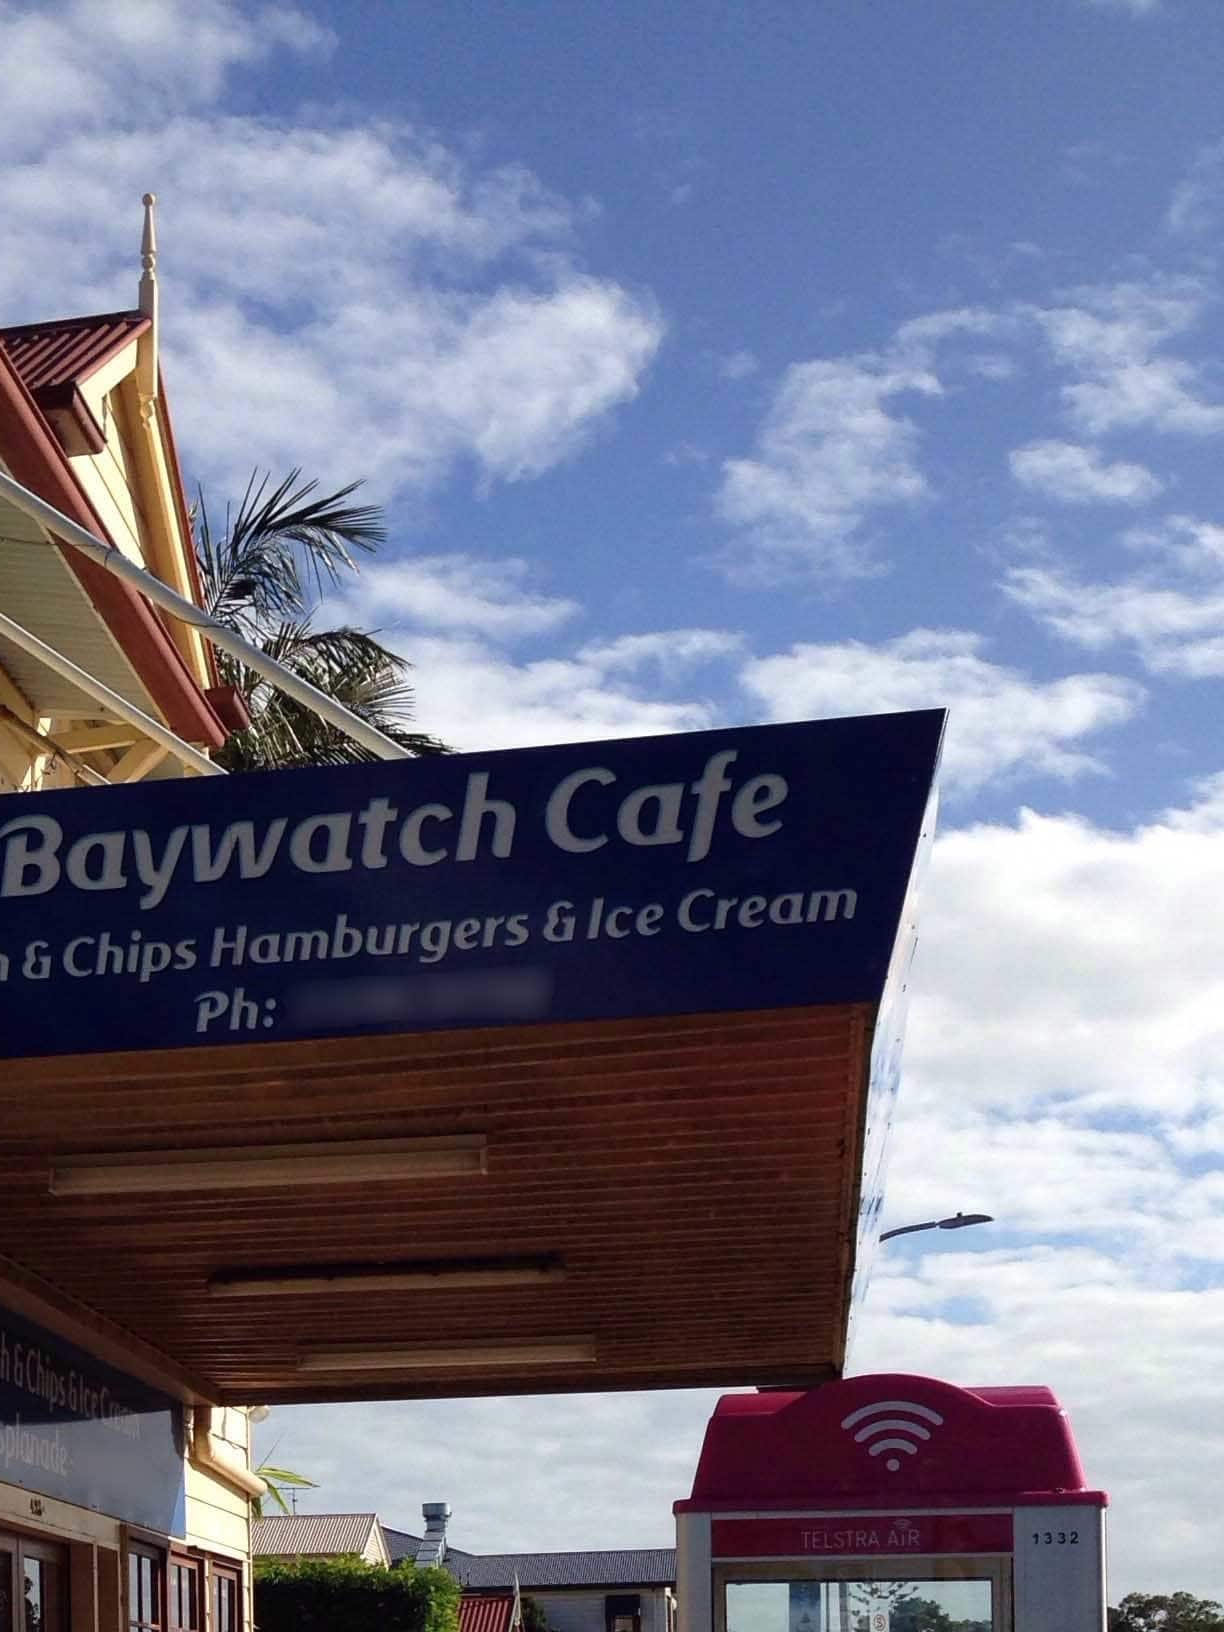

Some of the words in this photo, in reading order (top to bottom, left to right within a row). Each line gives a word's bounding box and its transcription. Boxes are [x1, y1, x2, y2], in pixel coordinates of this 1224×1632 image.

[545, 749, 790, 863] Cafe
[23, 941, 52, 980] &
[62, 930, 196, 982] Chips
[210, 912, 529, 968] Hamburgers
[544, 901, 575, 943] &
[588, 898, 665, 940] Ice
[678, 887, 859, 933] Cream
[196, 991, 278, 1034] Ph:
[26, 1347, 66, 1413] Chips
[801, 1530, 880, 1549] TELSTRA
[1032, 1531, 1080, 1545] 1332
